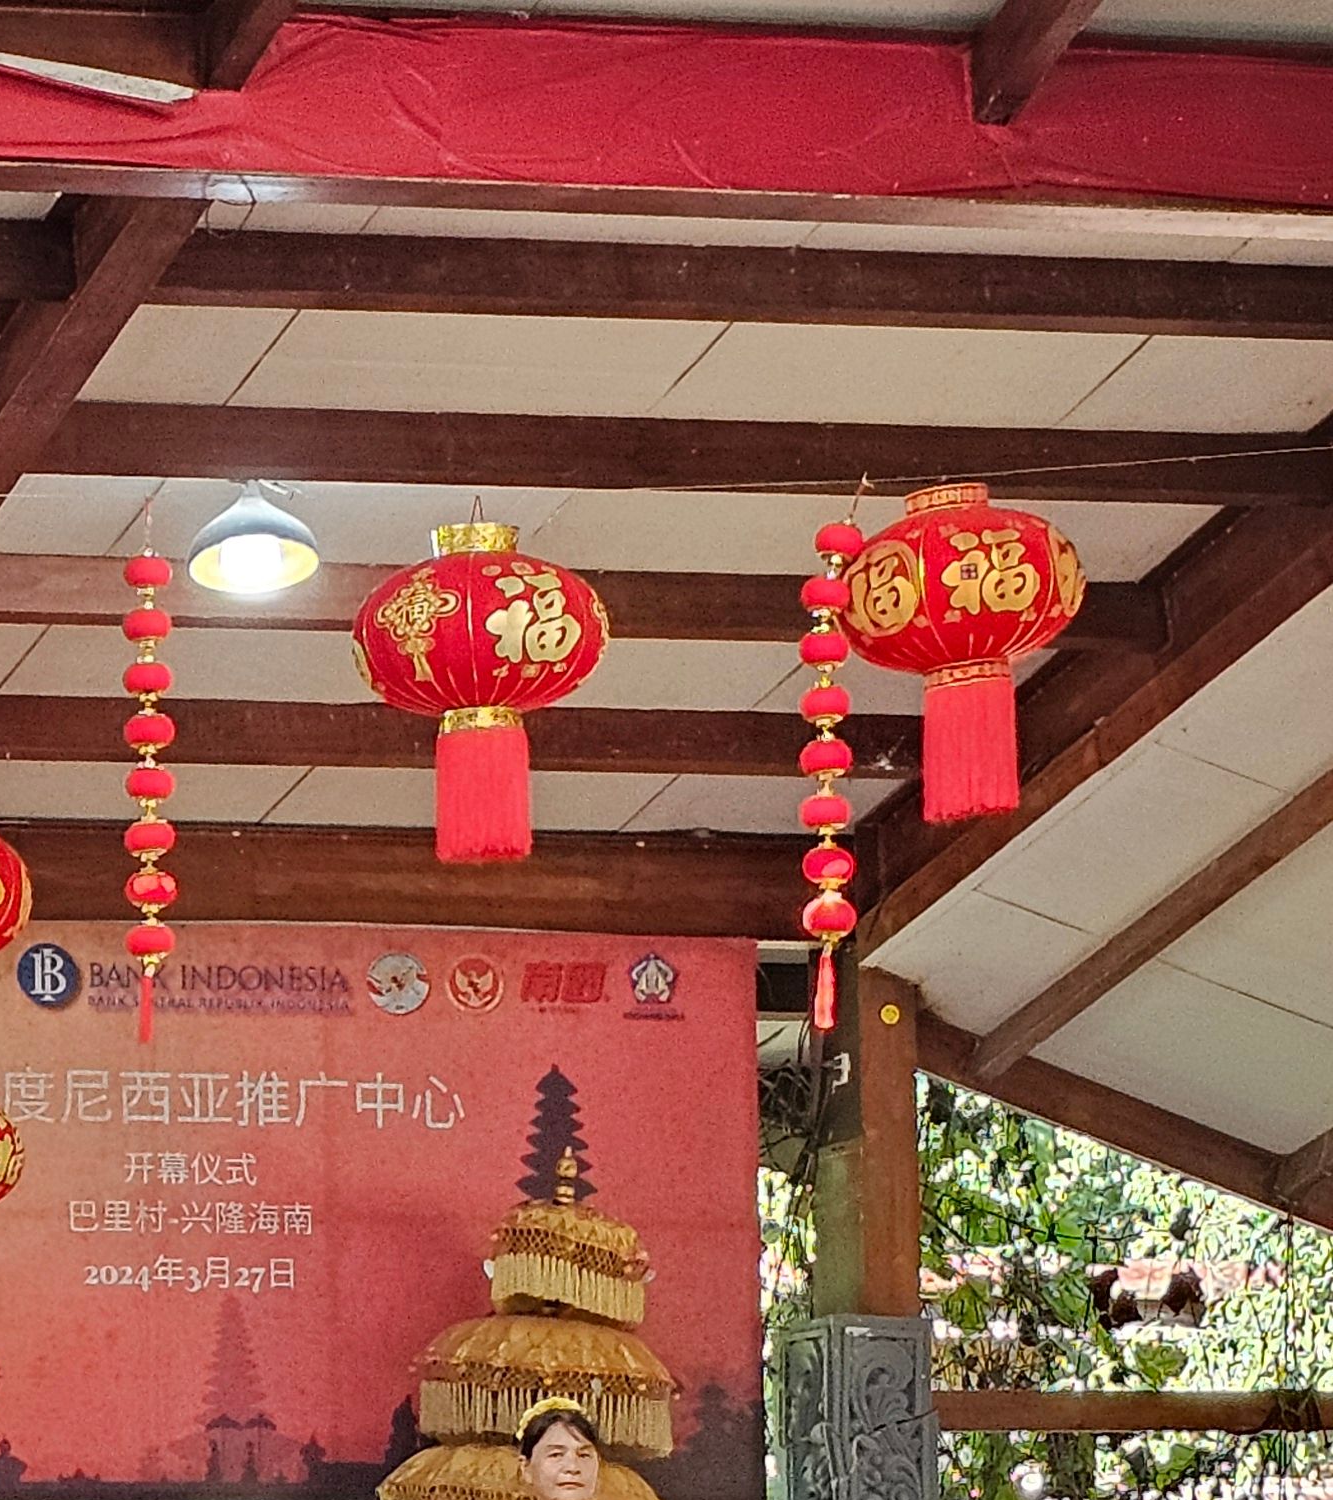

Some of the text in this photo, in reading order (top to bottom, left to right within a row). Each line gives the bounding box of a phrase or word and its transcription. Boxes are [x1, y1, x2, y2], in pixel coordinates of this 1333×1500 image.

[941, 530, 1040, 615] 福
[486, 573, 581, 663] 福
[90, 962, 348, 993] BANK INDONESIA
[124, 1152, 256, 1187] 开幕仪式
[68, 1200, 313, 1236] 巴里村-兴隆海南
[83, 1255, 296, 1293] 2024年3月27日
